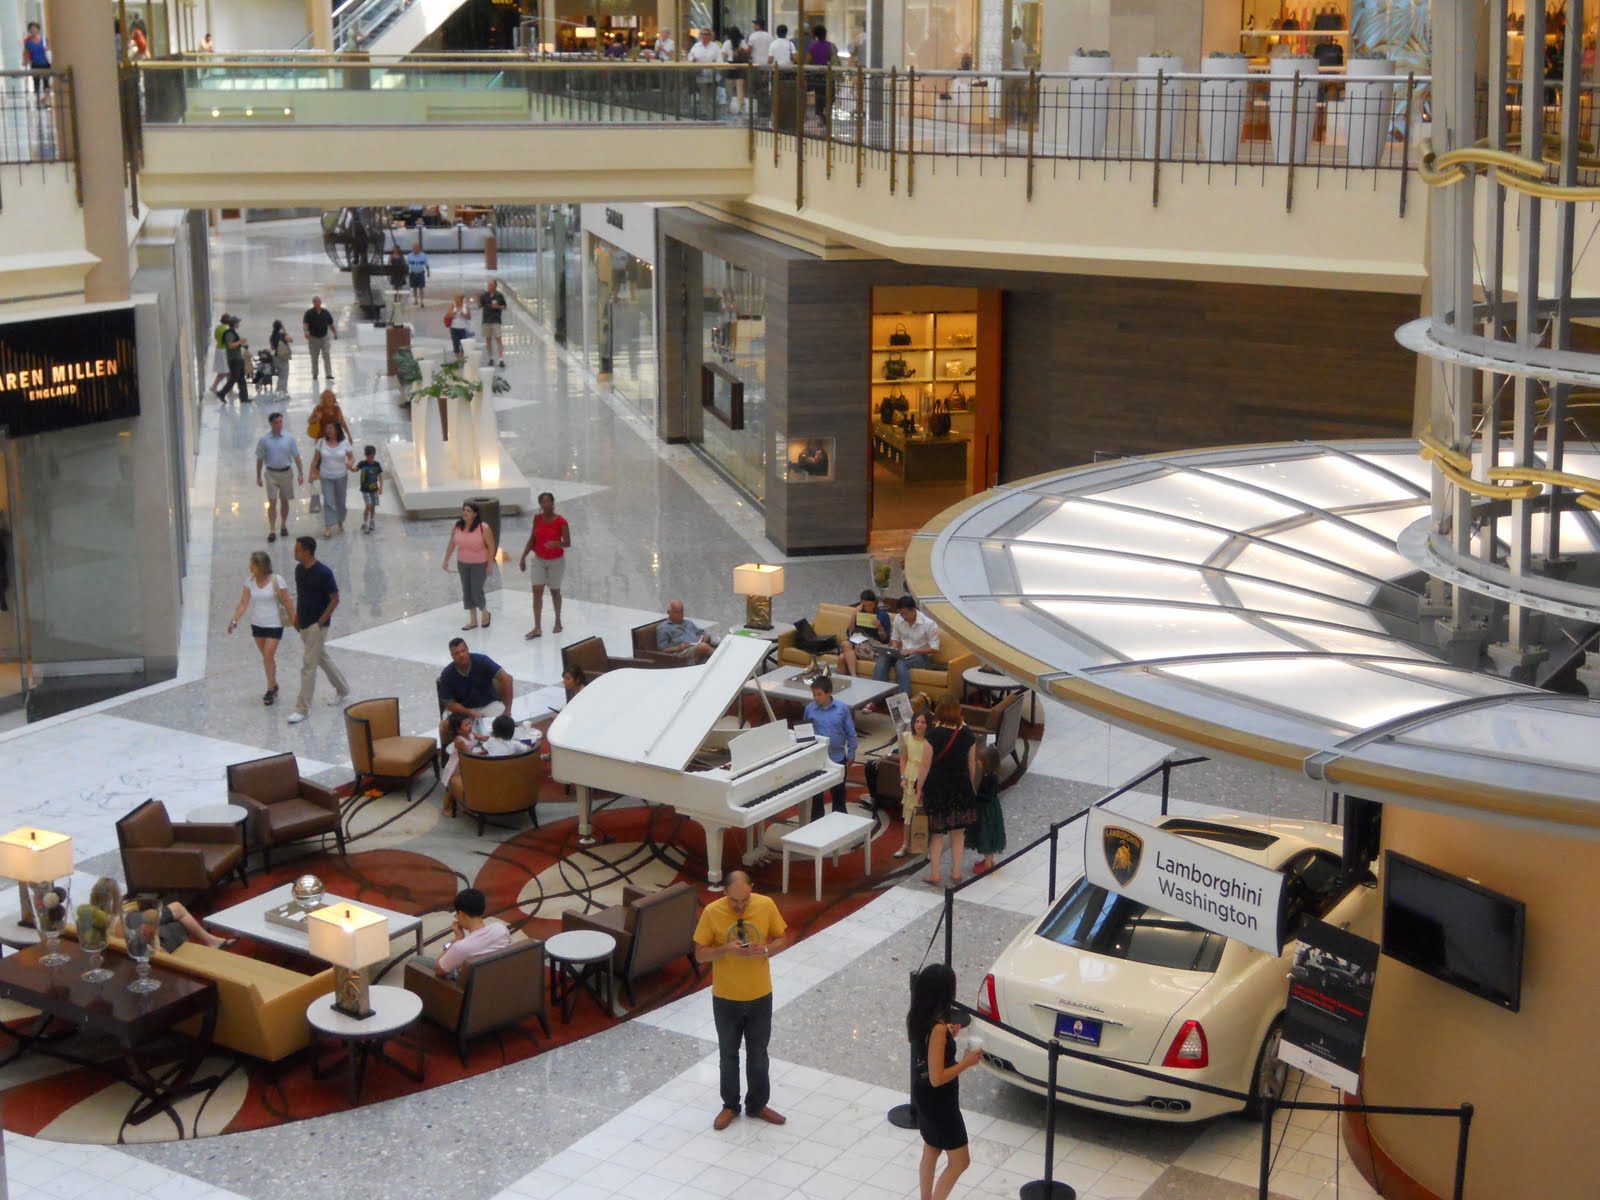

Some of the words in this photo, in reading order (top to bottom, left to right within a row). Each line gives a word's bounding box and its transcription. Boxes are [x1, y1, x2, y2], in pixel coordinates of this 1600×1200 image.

[52, 360, 118, 383] MILLEN
[29, 384, 77, 401] ENGLAND
[1156, 851, 1262, 907] Lamborghini
[1159, 877, 1258, 931] Washington
